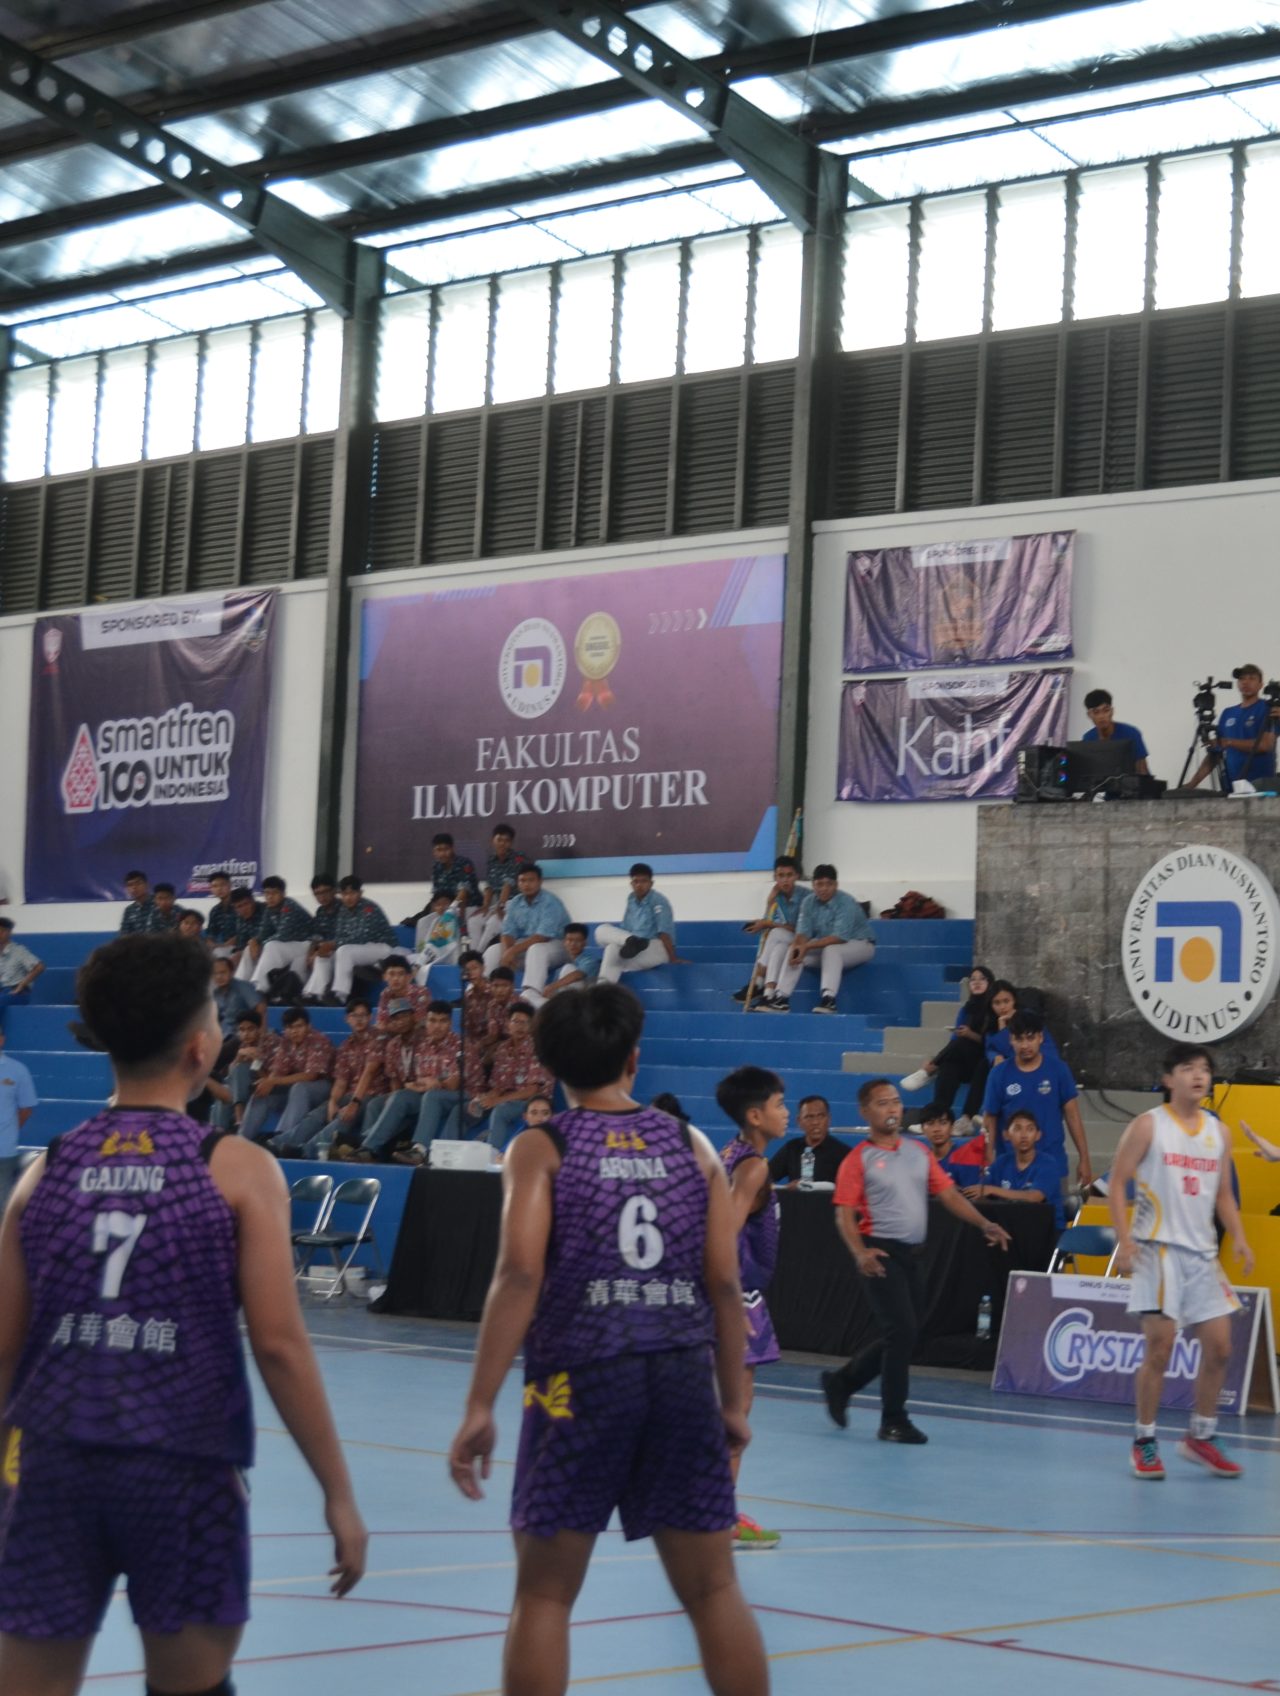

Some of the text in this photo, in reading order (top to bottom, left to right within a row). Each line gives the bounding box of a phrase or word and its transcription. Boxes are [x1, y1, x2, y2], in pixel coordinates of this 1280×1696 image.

[101, 612, 178, 635] SPONSORED
[101, 706, 230, 754] smartfren
[475, 727, 641, 771] FAKULTAS
[154, 751, 228, 780] UNTUK
[153, 781, 225, 800] INDONESIA
[411, 769, 710, 820] ILMU KOMPUTER
[1129, 852, 1269, 984] UNIVERSITAS DIAN NUSWANTORO
[1152, 997, 1241, 1035] UDINUS
[79, 1165, 166, 1193] GADING
[92, 1210, 148, 1299] 7
[617, 1194, 664, 1271] 6
[1048, 1311, 1200, 1377] CRYSTAN
